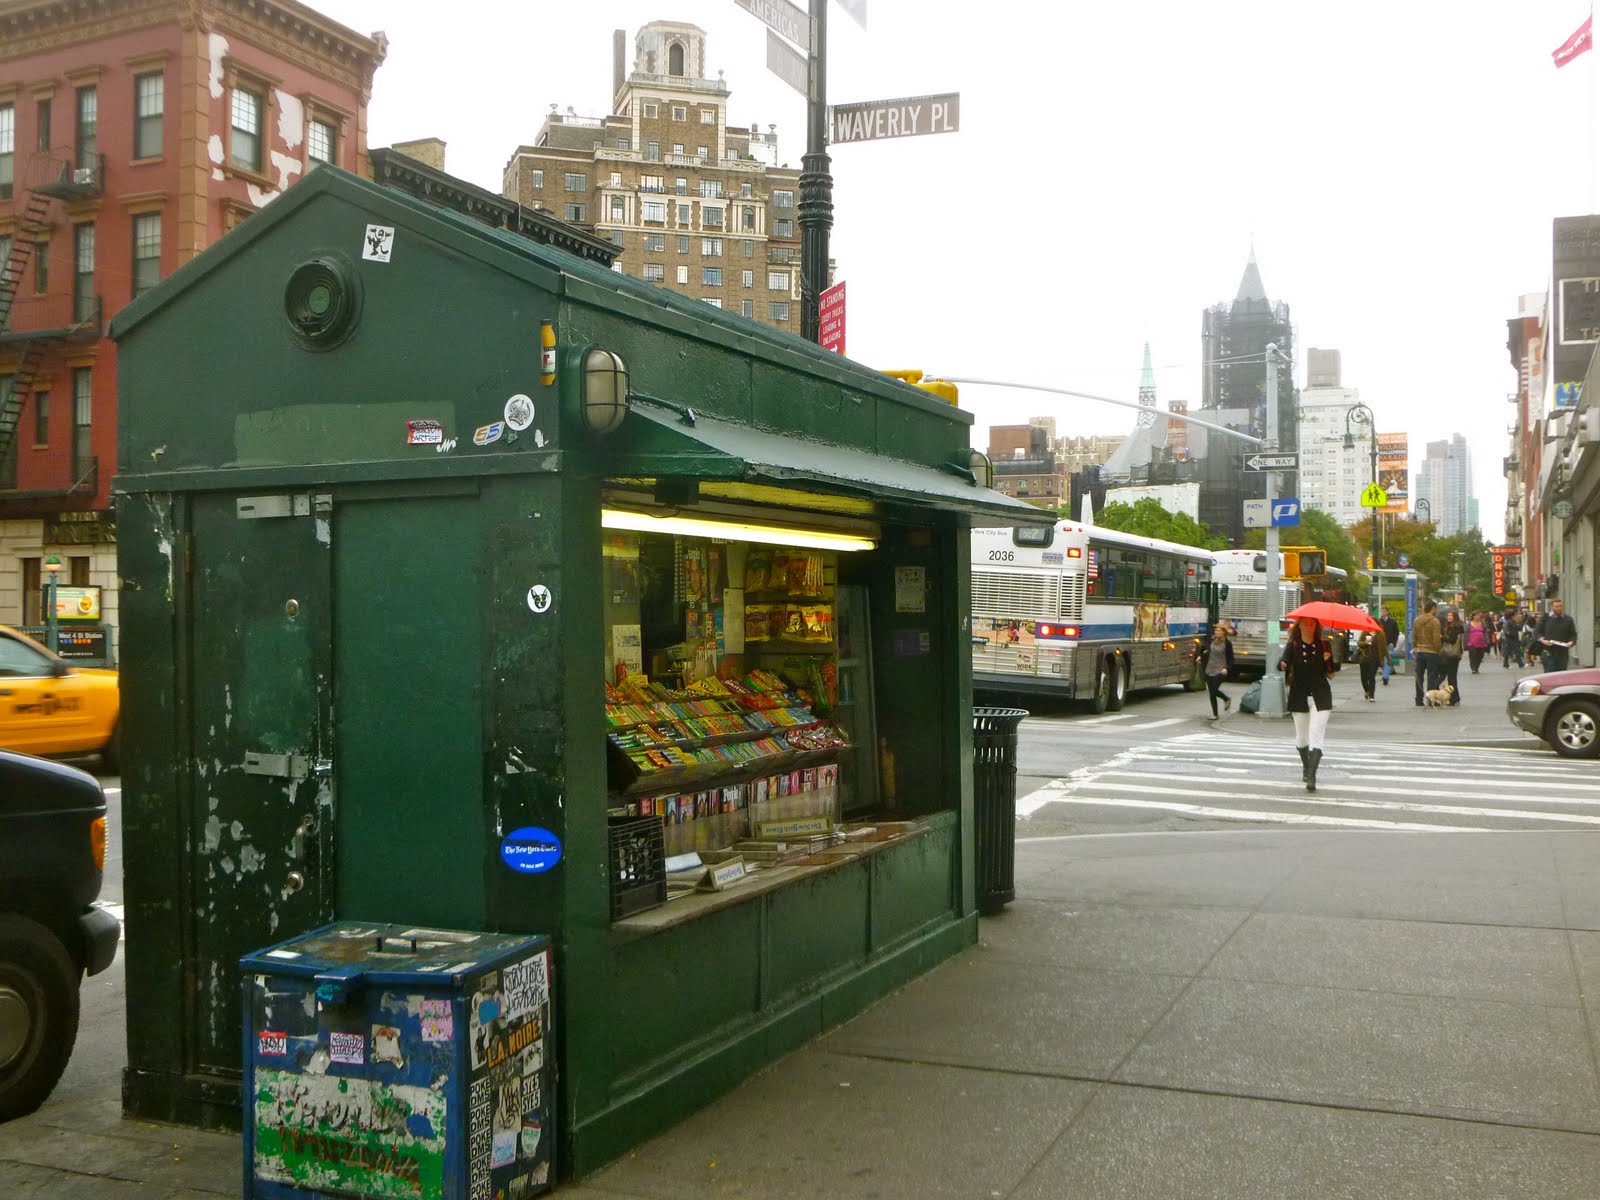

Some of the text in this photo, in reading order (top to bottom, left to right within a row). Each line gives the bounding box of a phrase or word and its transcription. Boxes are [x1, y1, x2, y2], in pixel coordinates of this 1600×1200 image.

[750, 0, 799, 43] AMERICAS
[837, 105, 921, 141] WAVERLY
[931, 102, 954, 132] PL
[820, 288, 845, 311] NO STANDING
[832, 305, 844, 318] TRUCKS
[822, 320, 837, 335] LOADING
[988, 550, 1015, 561] 2036
[1495, 555, 1503, 594] DRUGS
[508, 1020, 539, 1058] NOIRE
[470, 1079, 490, 1095] POKE
[470, 1090, 490, 1107] DMS
[470, 1104, 490, 1121] POKE
[470, 1115, 490, 1131] DMS
[470, 1128, 490, 1146] POKE
[471, 1141, 490, 1158] DMS
[471, 1156, 490, 1172] POKE
[471, 1180, 490, 1197] POKE
